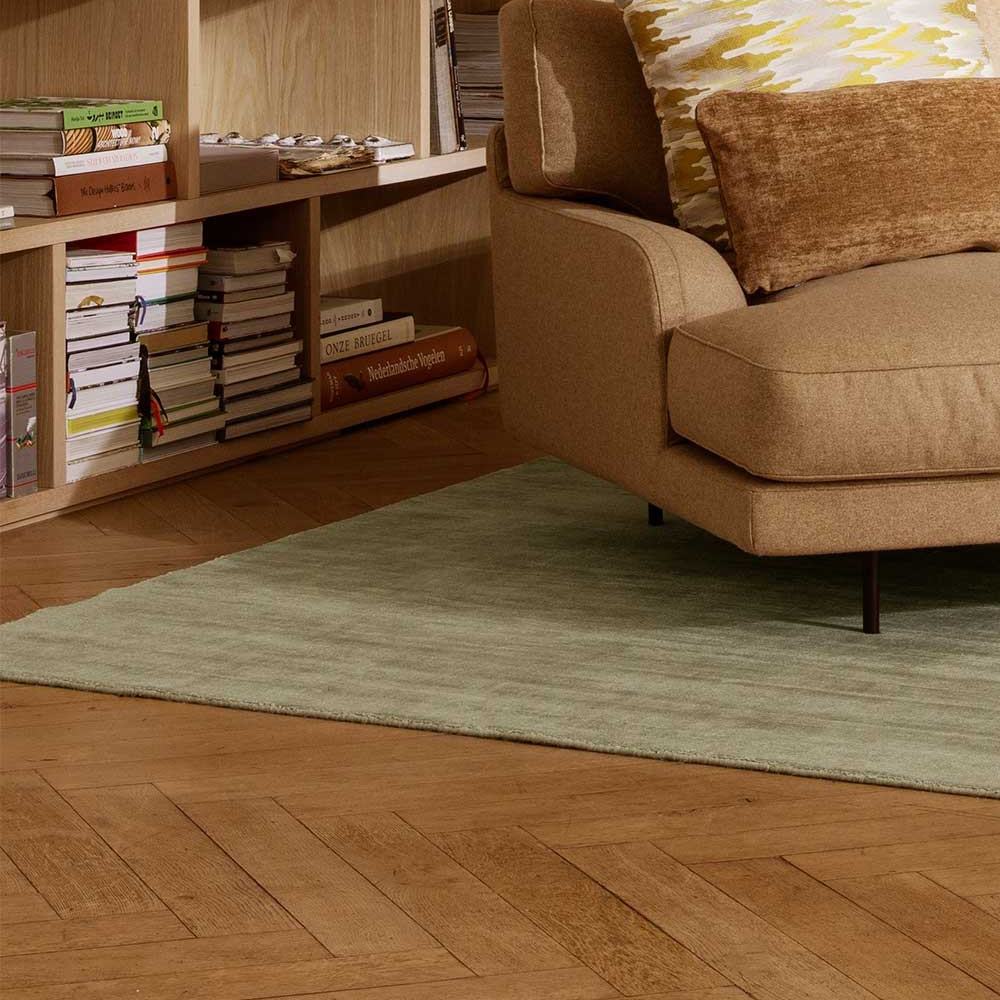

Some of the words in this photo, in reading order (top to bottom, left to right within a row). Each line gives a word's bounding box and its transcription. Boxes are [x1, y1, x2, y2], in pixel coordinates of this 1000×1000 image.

[325, 340, 350, 356] ONZE
[354, 329, 392, 350] BRUEGEL
[367, 355, 418, 382] Nederlandsche
[417, 348, 446, 371] Vogelen
